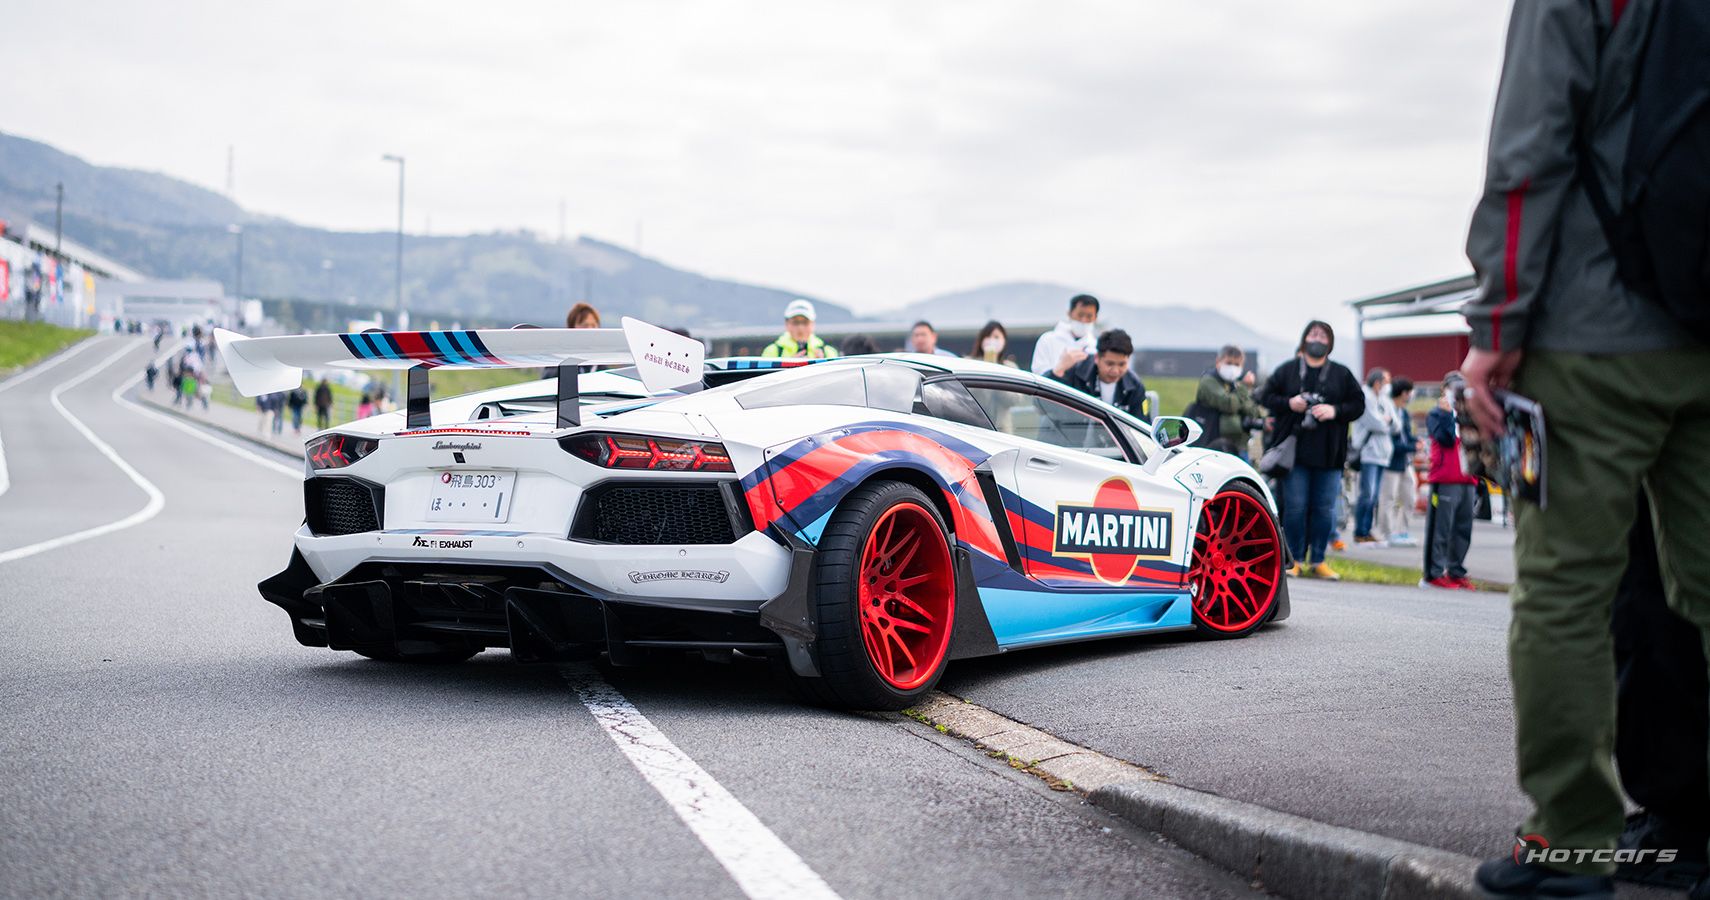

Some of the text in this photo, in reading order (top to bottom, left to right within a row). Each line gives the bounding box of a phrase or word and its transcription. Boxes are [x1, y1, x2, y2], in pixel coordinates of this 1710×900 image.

[432, 440, 482, 452] Lamborghini
[1062, 512, 1167, 549] MARTINI
[439, 540, 473, 548] EXHAUST
[636, 571, 721, 581] CHROME HEARTS
